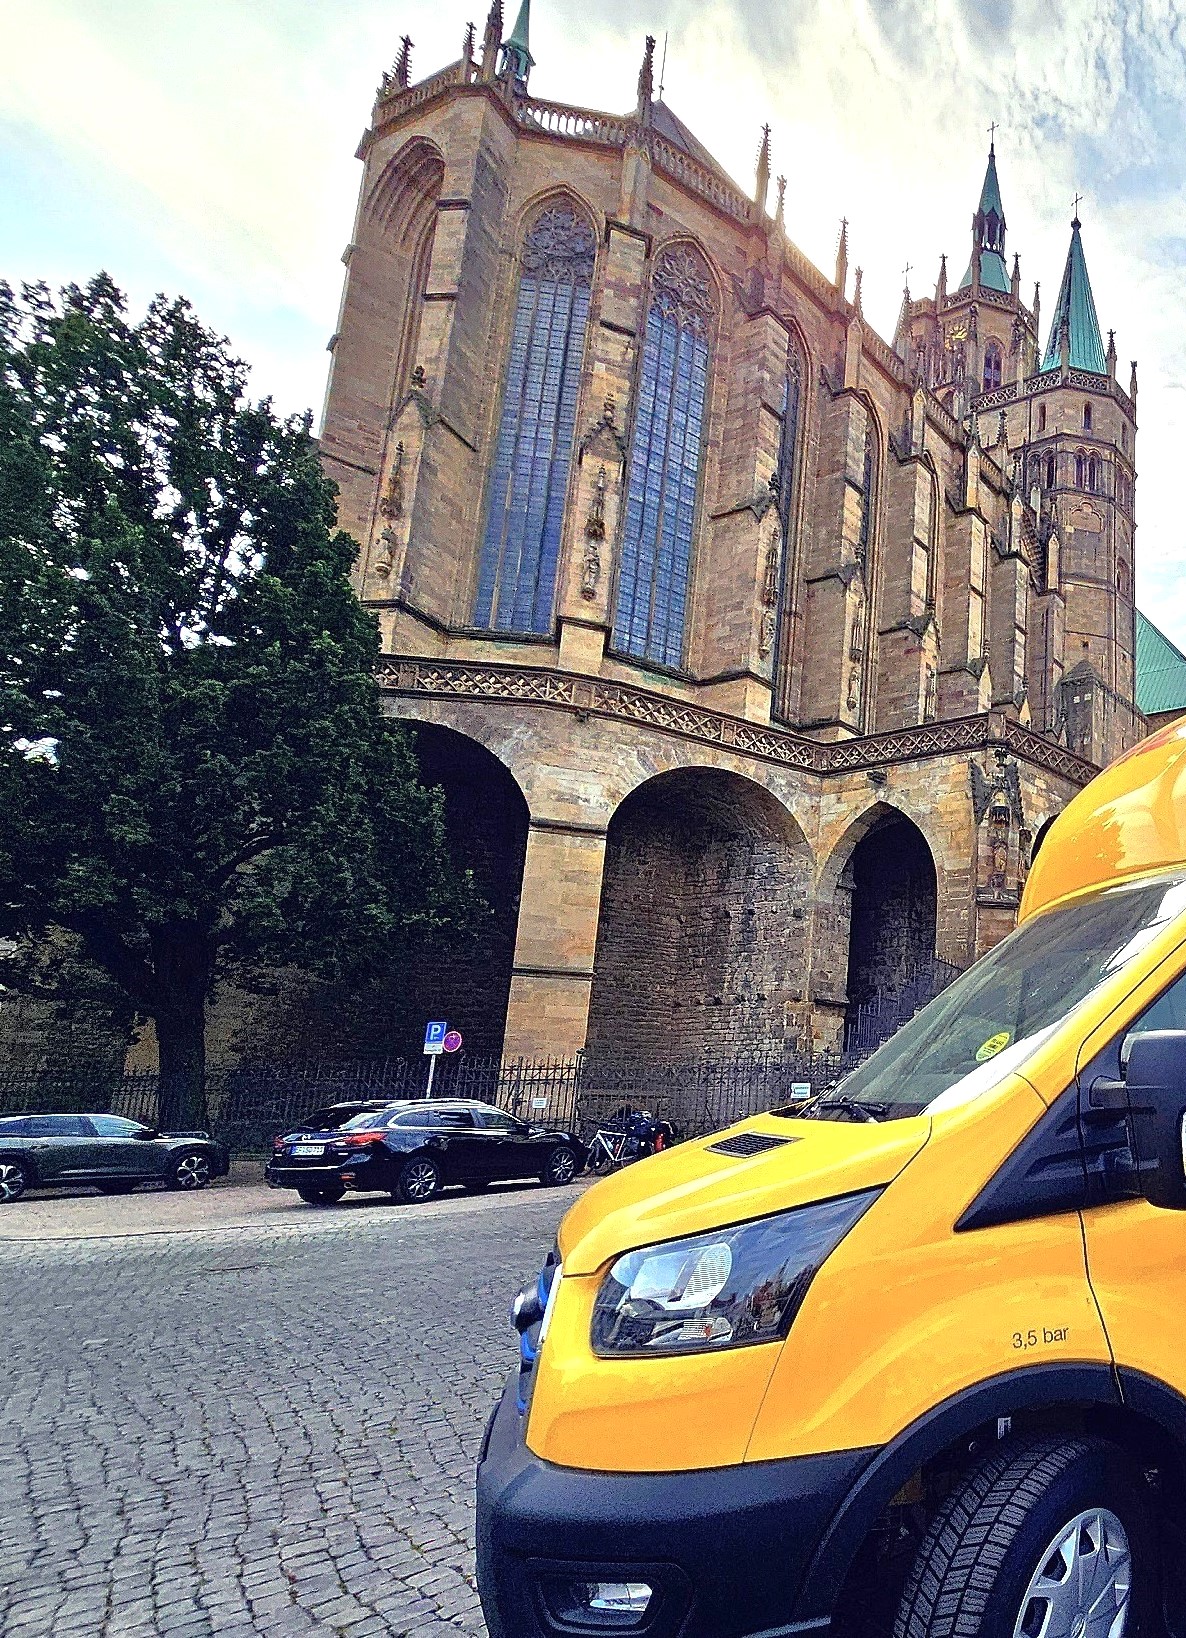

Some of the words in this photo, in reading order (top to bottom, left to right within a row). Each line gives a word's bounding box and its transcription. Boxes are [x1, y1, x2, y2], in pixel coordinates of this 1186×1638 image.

[430, 1024, 442, 1040] P
[1012, 1329, 1037, 1350] 3,5
[1043, 1327, 1069, 1344] bar
